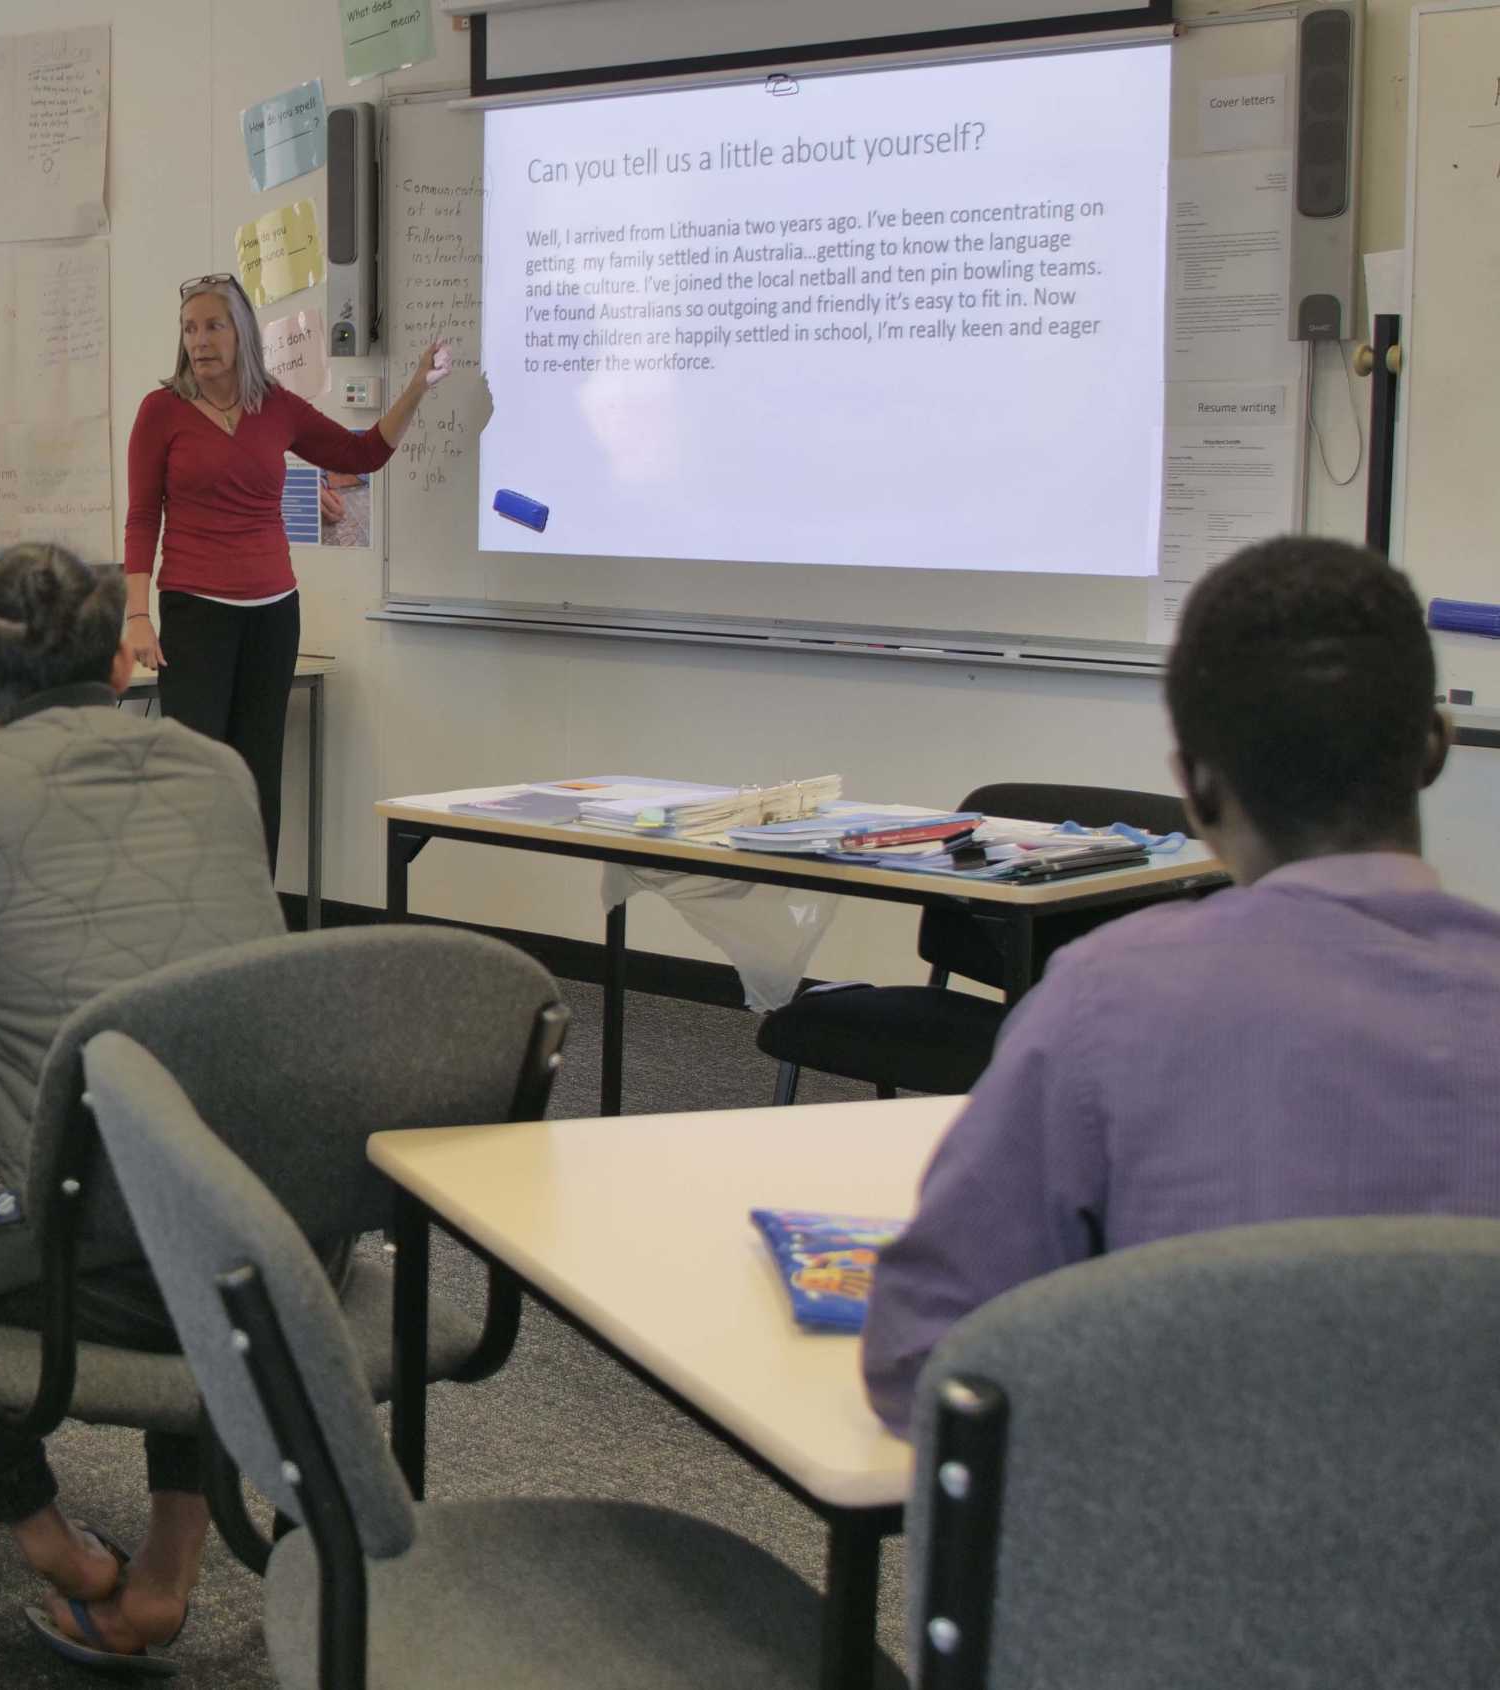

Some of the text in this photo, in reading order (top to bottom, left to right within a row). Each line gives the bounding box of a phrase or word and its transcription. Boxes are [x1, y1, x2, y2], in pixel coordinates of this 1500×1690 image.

[1209, 95, 1276, 109] Cover letters
[528, 121, 985, 186] Can you tell us a little about yourself?
[526, 229, 561, 248] Well,
[566, 228, 570, 244] I
[574, 224, 625, 245] arrived
[630, 223, 665, 242] from
[669, 220, 740, 239] Lithuania
[744, 218, 775, 235] two
[779, 216, 822, 237] years
[828, 214, 861, 234] ago.
[901, 208, 945, 227] been
[950, 200, 1074, 223] concentrating
[1080, 200, 1104, 216] on
[526, 257, 575, 276] getting
[583, 256, 604, 272] my
[609, 252, 654, 270] family
[658, 247, 710, 266] settled
[714, 246, 728, 264] in
[880, 238, 897, 256] to
[903, 236, 949, 255] know
[955, 235, 984, 252] the
[989, 231, 1071, 254] language
[526, 279, 551, 297] and
[556, 279, 580, 296] the
[584, 277, 640, 295] culture.
[673, 272, 722, 296] joined
[727, 270, 753, 289] the
[758, 270, 794, 288] local
[799, 267, 856, 287] netball
[861, 265, 891, 284] and
[898, 265, 925, 282] ten
[931, 263, 957, 285] pin
[963, 259, 1034, 282] bowling
[1040, 259, 1102, 278] teams.
[554, 304, 595, 321] found
[599, 300, 682, 320] Australians
[685, 303, 703, 317] so
[707, 297, 777, 320] outgoing
[781, 296, 811, 314] and
[817, 293, 880, 316] friendly
[914, 294, 952, 313] easy
[958, 291, 976, 308] to
[982, 288, 1001, 307] fit
[1006, 288, 1028, 307] in.
[1034, 287, 1076, 306] Now
[525, 331, 553, 348] that
[558, 333, 579, 350] my
[583, 328, 642, 346] children
[646, 330, 670, 345] are
[675, 325, 731, 347] happily
[735, 324, 789, 343] settled
[795, 324, 808, 341] in
[814, 322, 872, 344] school,
[909, 319, 955, 342] really
[961, 318, 1003, 337] keen
[1009, 317, 1043, 336] and
[1048, 318, 1101, 339] eager
[524, 353, 715, 372] to re-enter the workforce.
[1197, 402, 1276, 415] Resume writing
